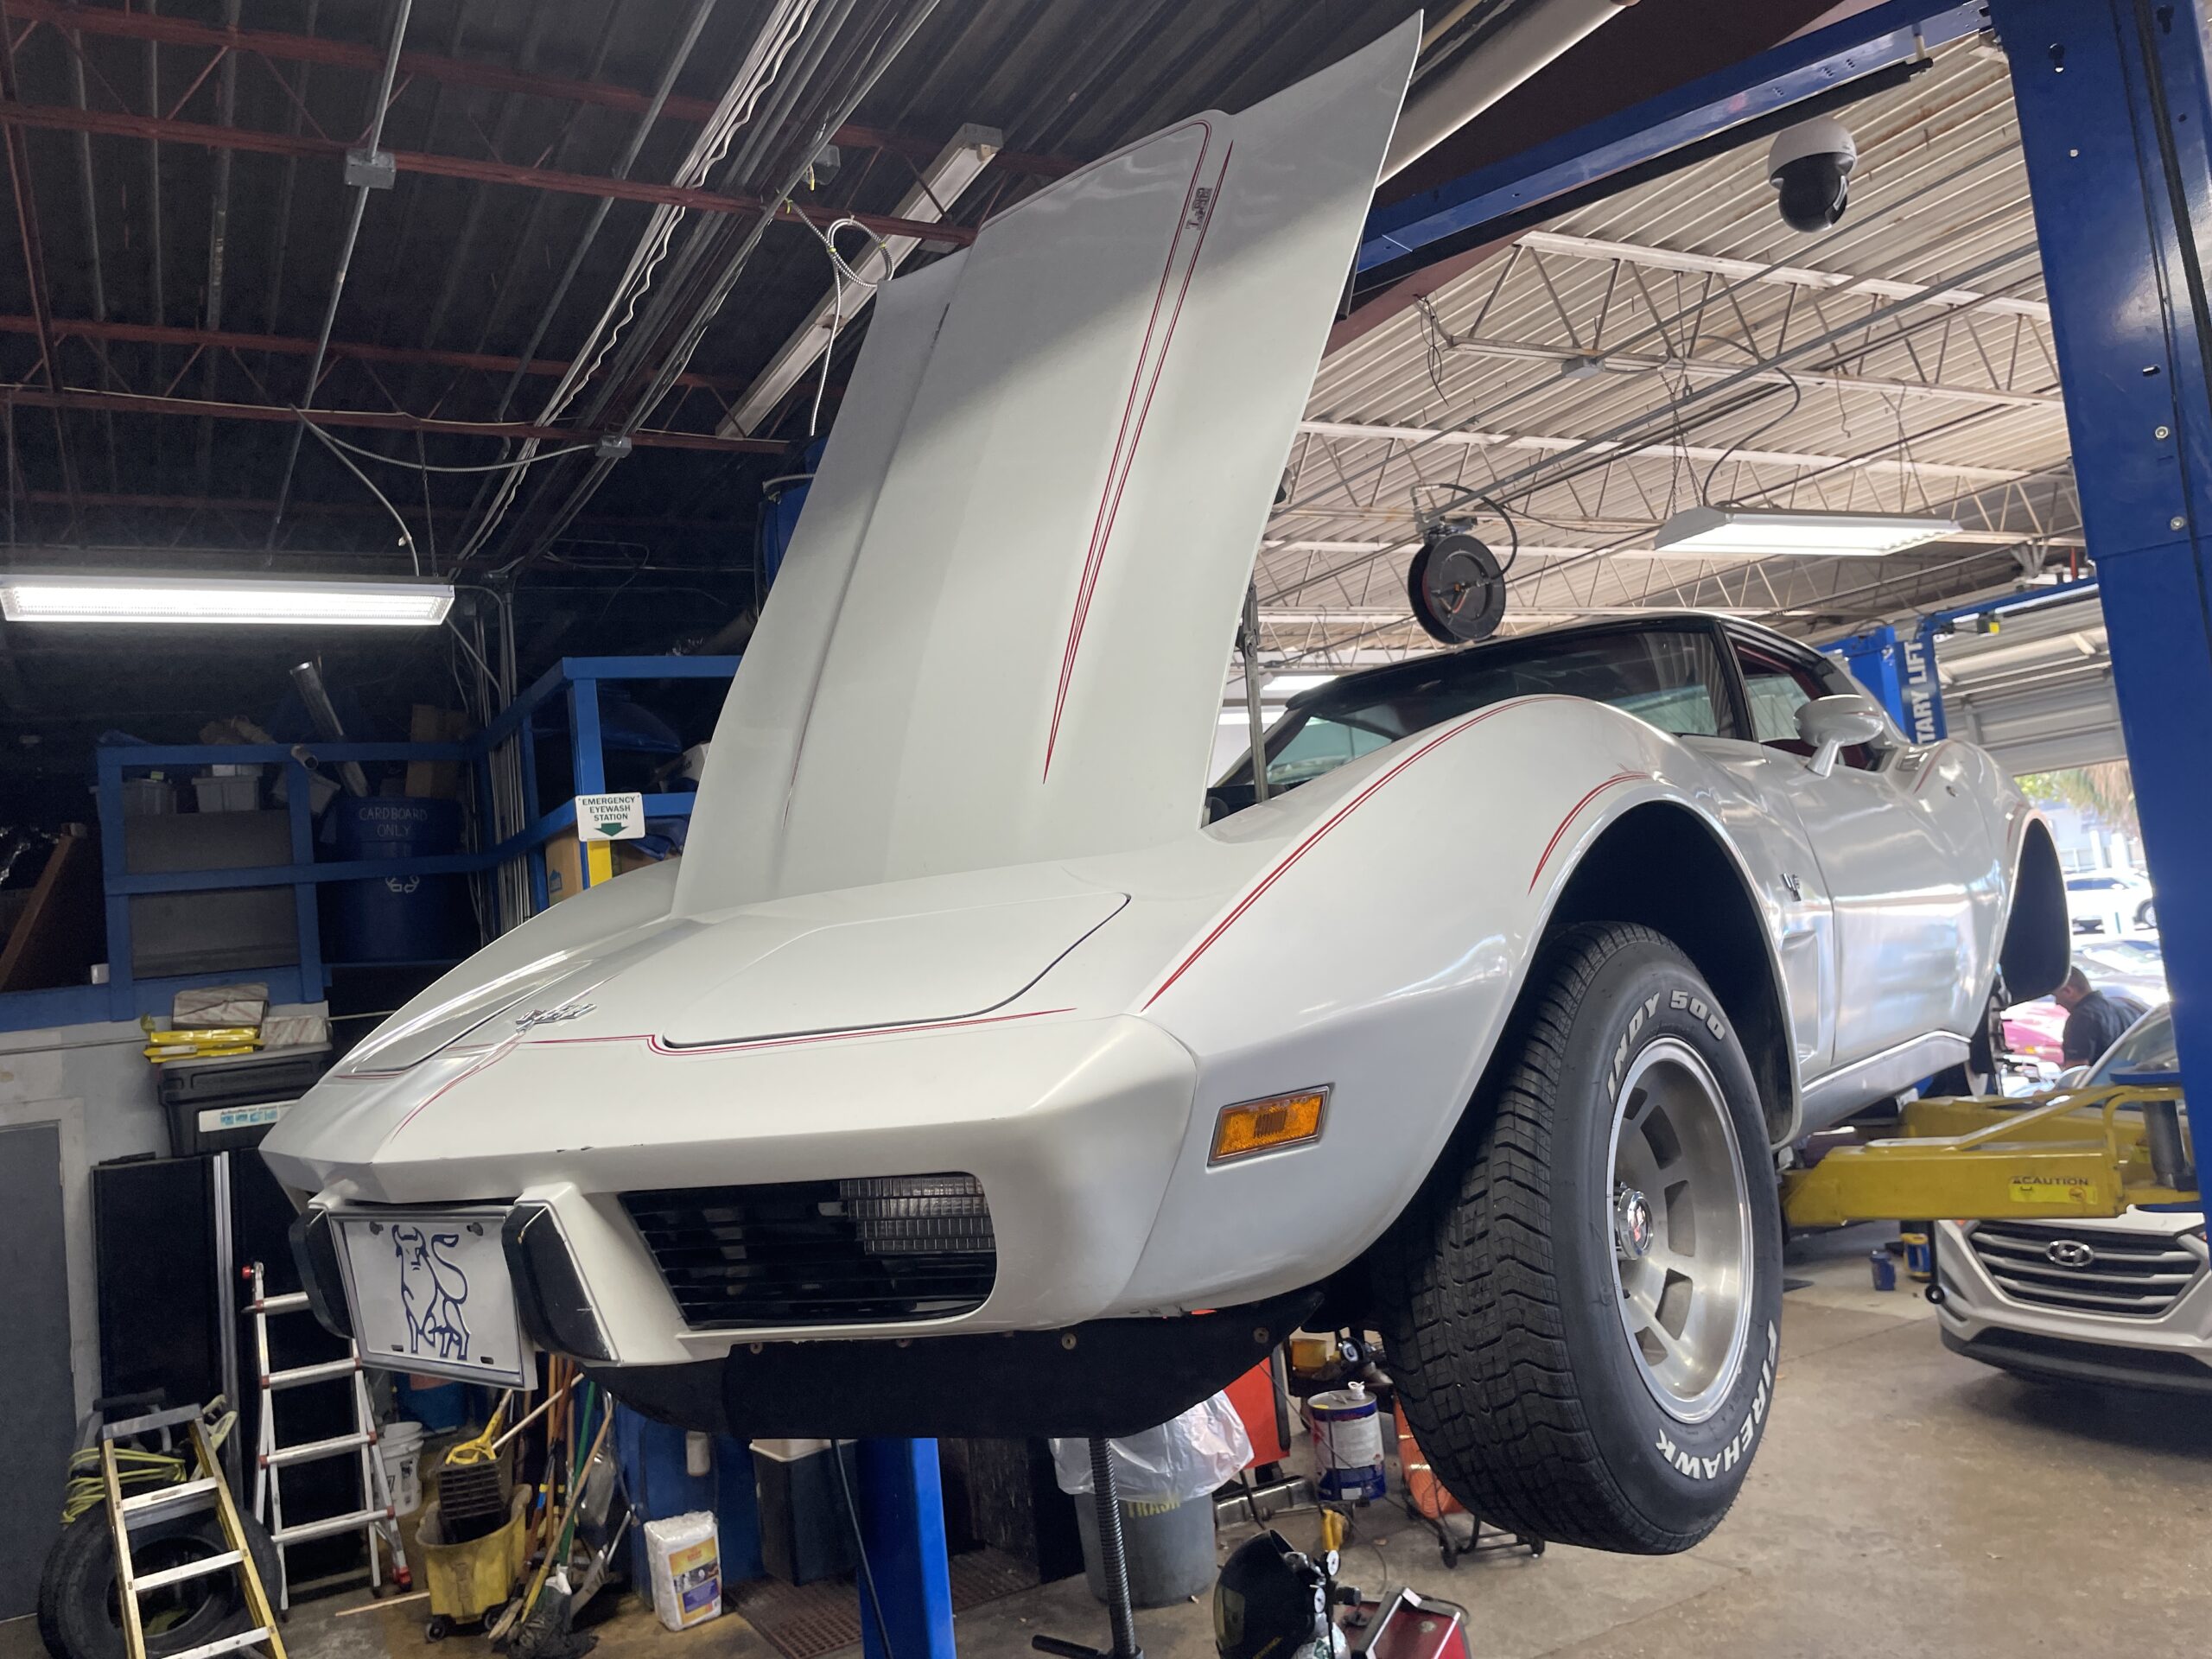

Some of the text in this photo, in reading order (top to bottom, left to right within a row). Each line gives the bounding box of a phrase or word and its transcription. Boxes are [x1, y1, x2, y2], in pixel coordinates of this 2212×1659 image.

[1904, 641, 1928, 684] LIFT
[582, 796, 635, 805] EMERGENCY
[359, 807, 428, 821] CARDBOARD
[589, 804, 631, 814] EYEWASH
[594, 813, 628, 822] STATION
[377, 823, 411, 837] ONLY
[1607, 989, 1726, 1103] INDY 500
[2022, 1176, 2088, 1185] CAUTION
[1655, 1319, 1777, 1479] FIREHAWK
